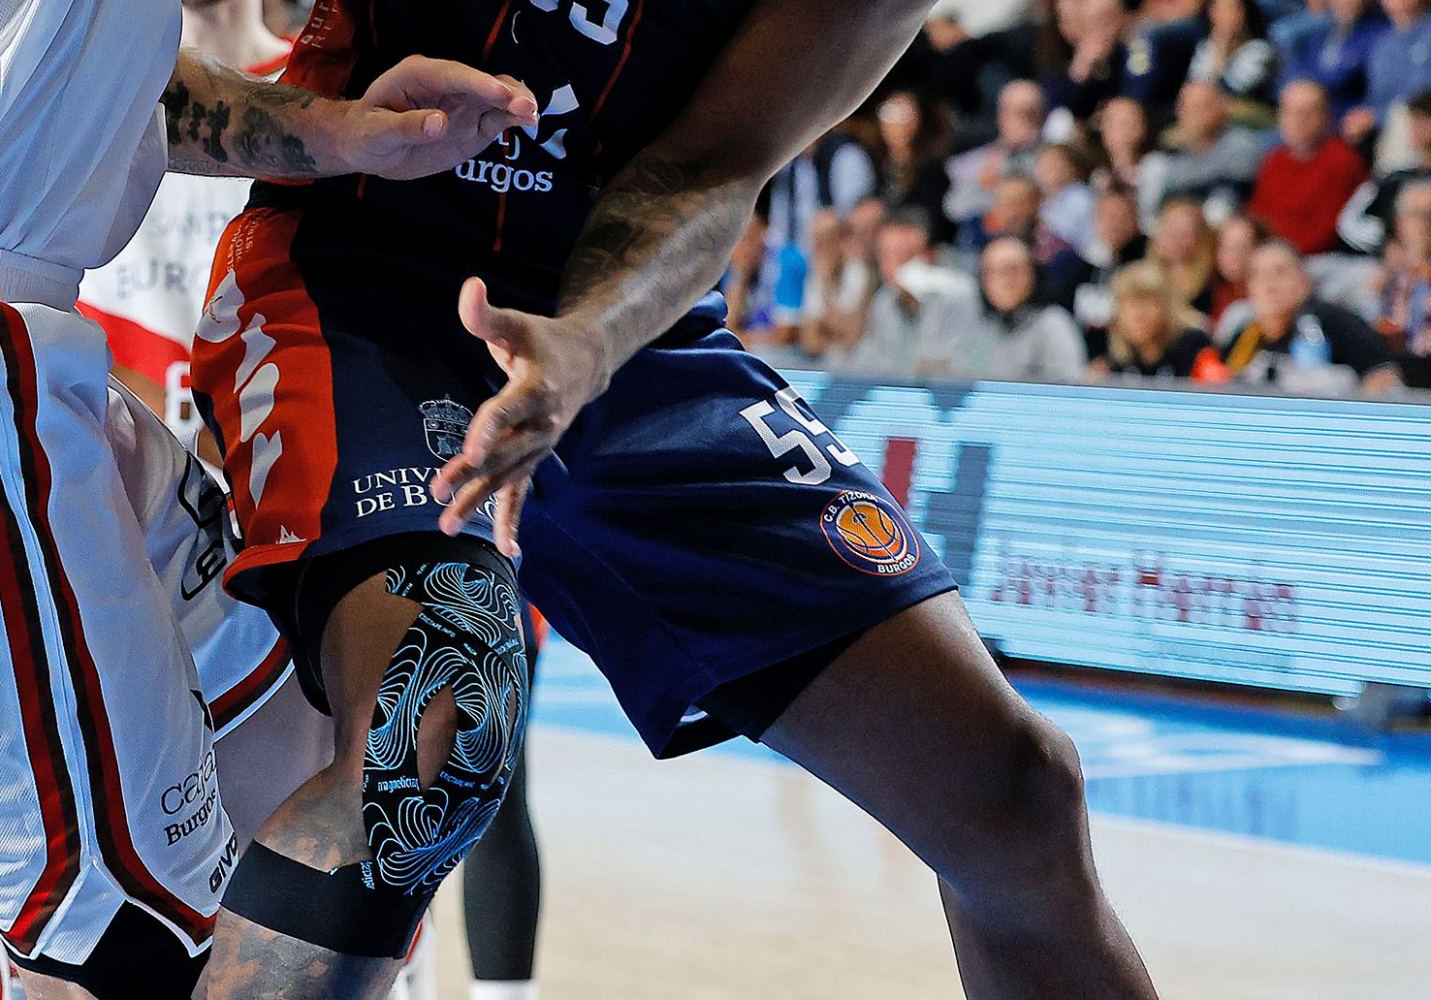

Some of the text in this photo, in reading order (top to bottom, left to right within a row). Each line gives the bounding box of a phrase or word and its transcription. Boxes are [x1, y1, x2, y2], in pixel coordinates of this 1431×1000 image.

[739, 385, 861, 486] 55
[355, 492, 396, 519] DE
[877, 552, 916, 573] BURGOS
[161, 751, 217, 816] Caja
